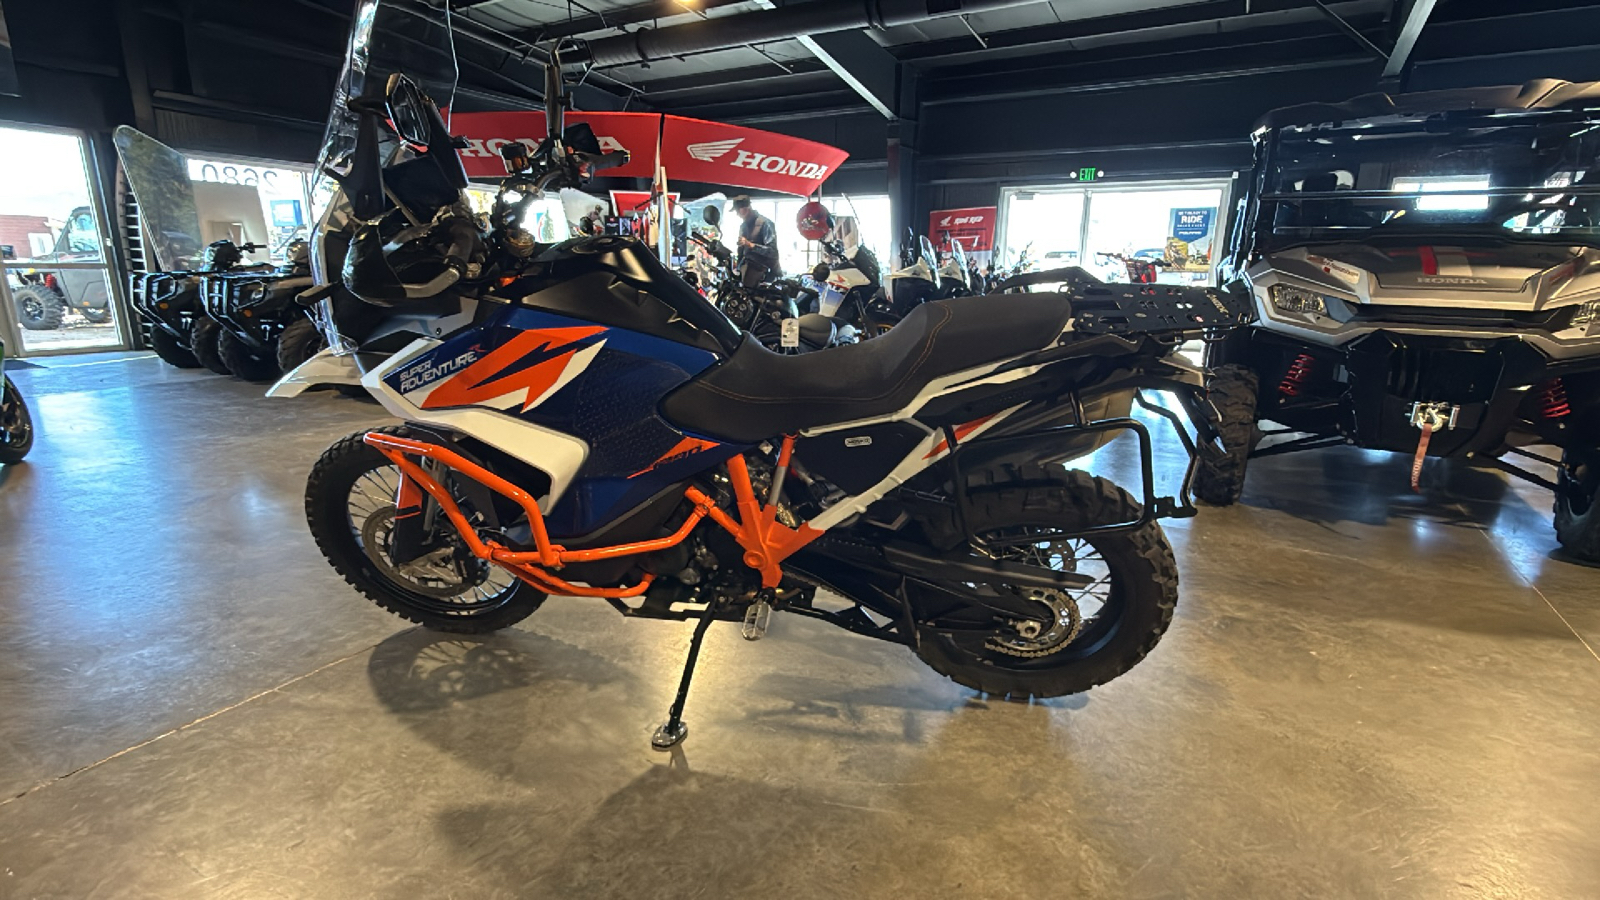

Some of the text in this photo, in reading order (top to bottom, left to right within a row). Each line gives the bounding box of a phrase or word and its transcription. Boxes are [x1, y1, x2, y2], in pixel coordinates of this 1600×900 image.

[730, 150, 828, 179] HONDA
[1079, 168, 1096, 181] EXIT
[1181, 215, 1203, 223] RIDE
[400, 360, 431, 381] SUPER
[401, 351, 477, 392] ADVENTURE
